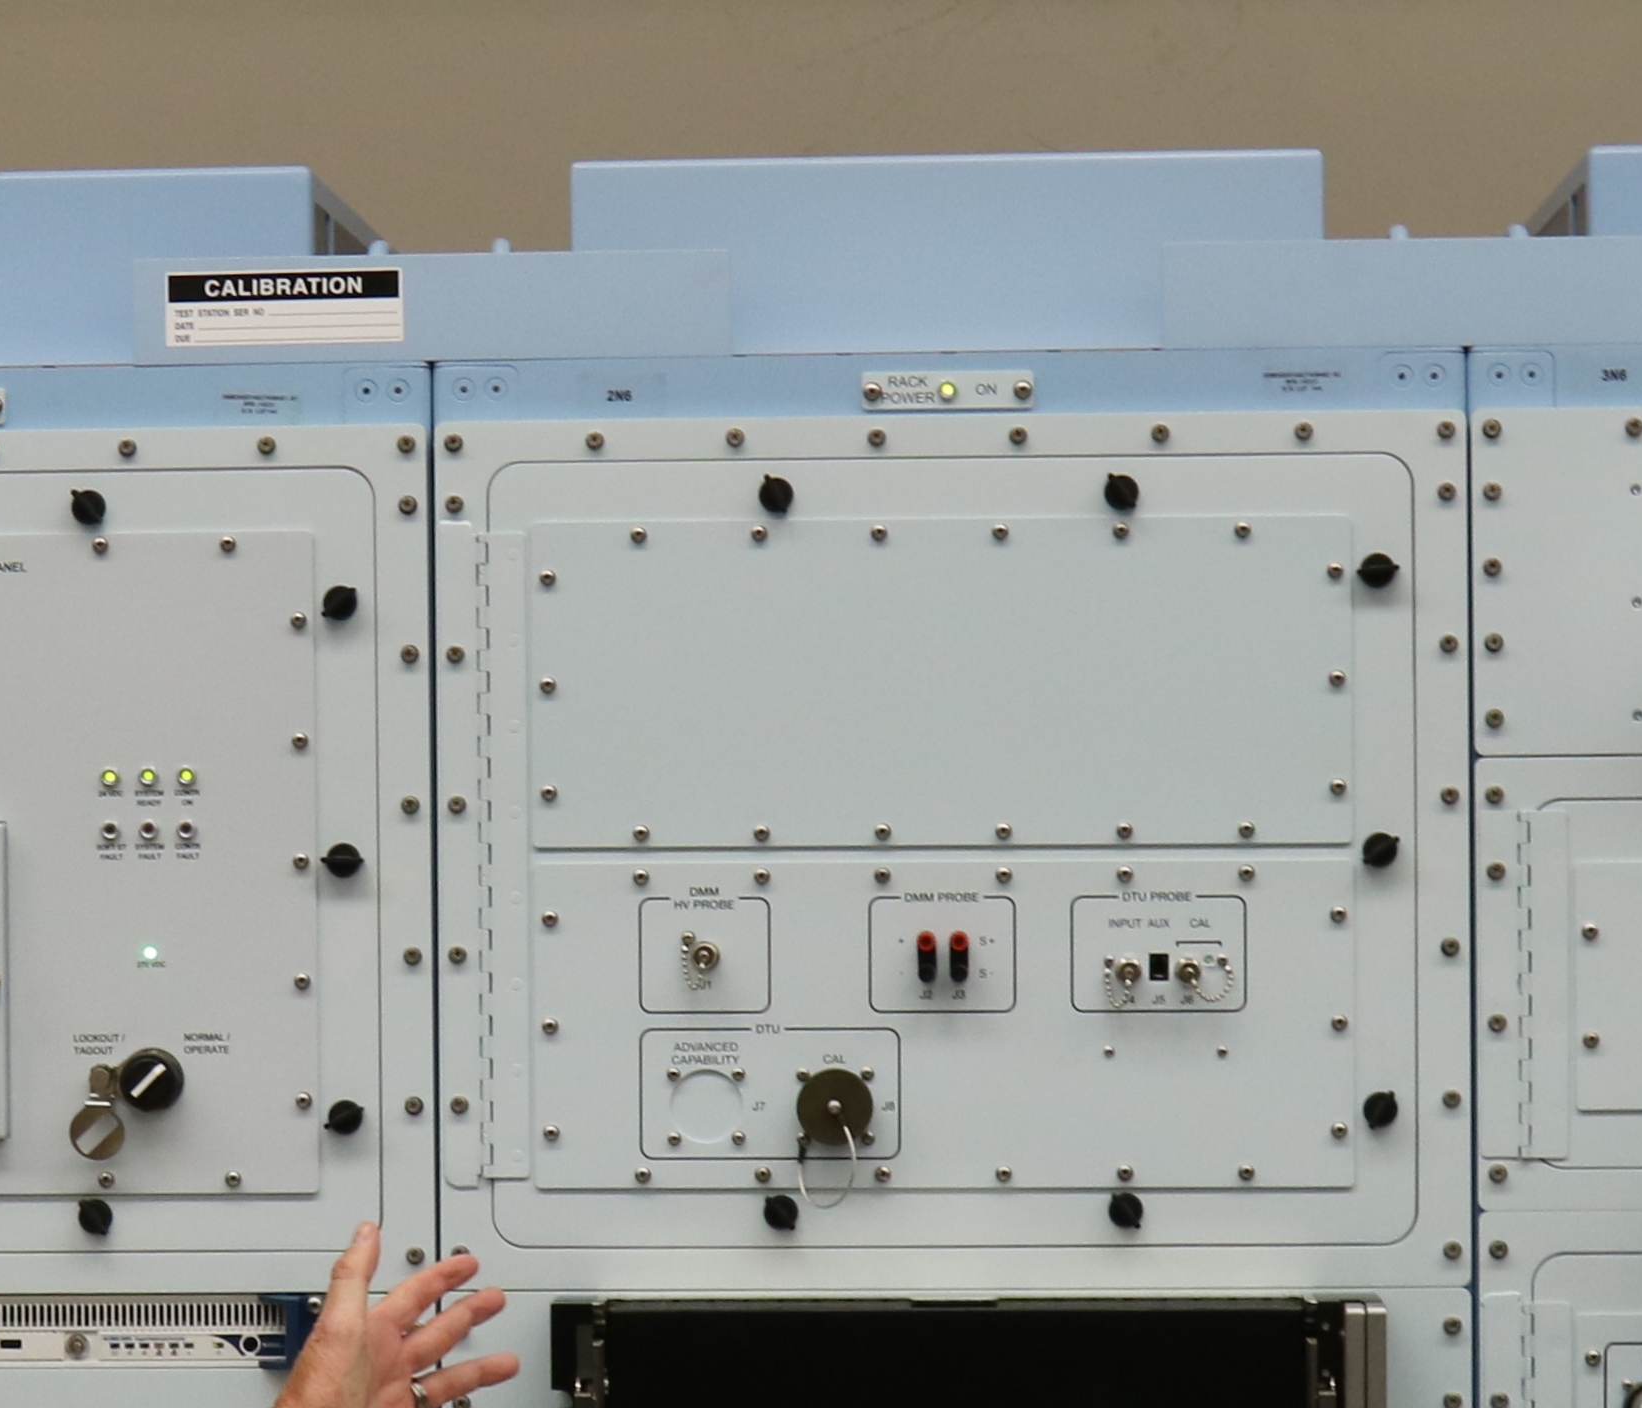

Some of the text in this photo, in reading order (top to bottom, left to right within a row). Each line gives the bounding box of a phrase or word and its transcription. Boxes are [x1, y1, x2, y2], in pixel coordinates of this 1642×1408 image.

[204, 276, 363, 297] CALIBRATION
[174, 309, 193, 317] TEST
[198, 308, 230, 317] STATION
[174, 322, 194, 330] DATE
[174, 334, 190, 343] DUE
[887, 375, 929, 388] RACK
[975, 383, 998, 396] ON
[881, 390, 936, 405] POWER
[689, 887, 719, 898] DMM
[904, 892, 979, 903] DMM PROBE
[1122, 891, 1191, 903] DTU PROBE
[674, 899, 735, 910] HV PROBE
[1108, 918, 1142, 929] INPUT
[1147, 918, 1170, 929] AUX
[1190, 918, 1211, 929] CAL
[919, 990, 933, 1001] J2
[952, 990, 966, 1001] J3
[1152, 993, 1166, 1004] J5
[1180, 993, 1194, 1004] J6
[756, 1023, 780, 1035] DTU
[74, 1034, 120, 1043] LOCKOUT
[184, 1033, 224, 1041] NORMAL
[74, 1047, 113, 1055] TAGOUT
[184, 1046, 230, 1054] OPERATE
[674, 1042, 739, 1053] ADVANCED
[671, 1054, 739, 1066] CAPABILITY
[823, 1054, 846, 1064] CAL
[752, 1101, 766, 1112] J7
[881, 1101, 896, 1112] J8
